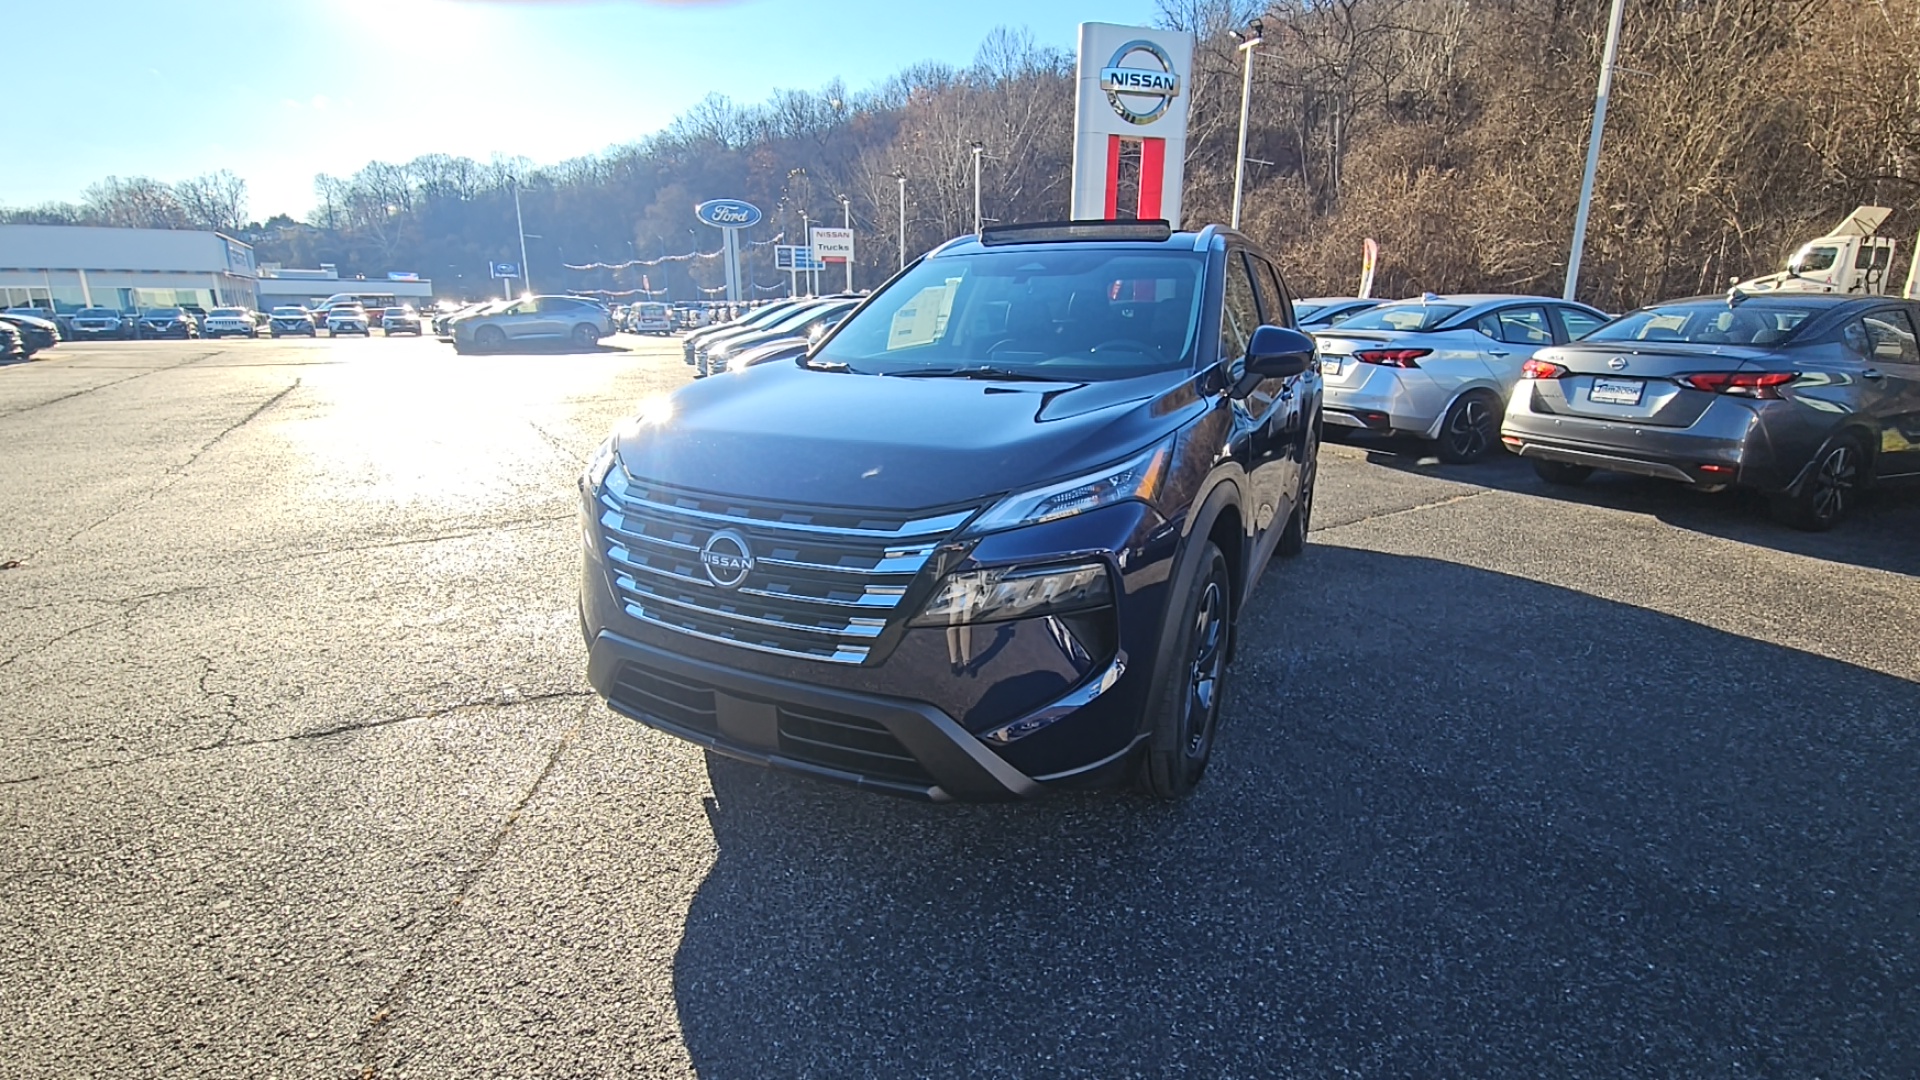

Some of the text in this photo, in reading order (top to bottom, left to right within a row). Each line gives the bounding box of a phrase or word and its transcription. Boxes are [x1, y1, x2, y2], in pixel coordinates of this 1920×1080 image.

[1110, 72, 1175, 91] NISSAN
[711, 204, 749, 222] Ford
[816, 231, 850, 239] NISSAN
[817, 243, 850, 251] Trucks
[700, 549, 752, 569] NISSAN
